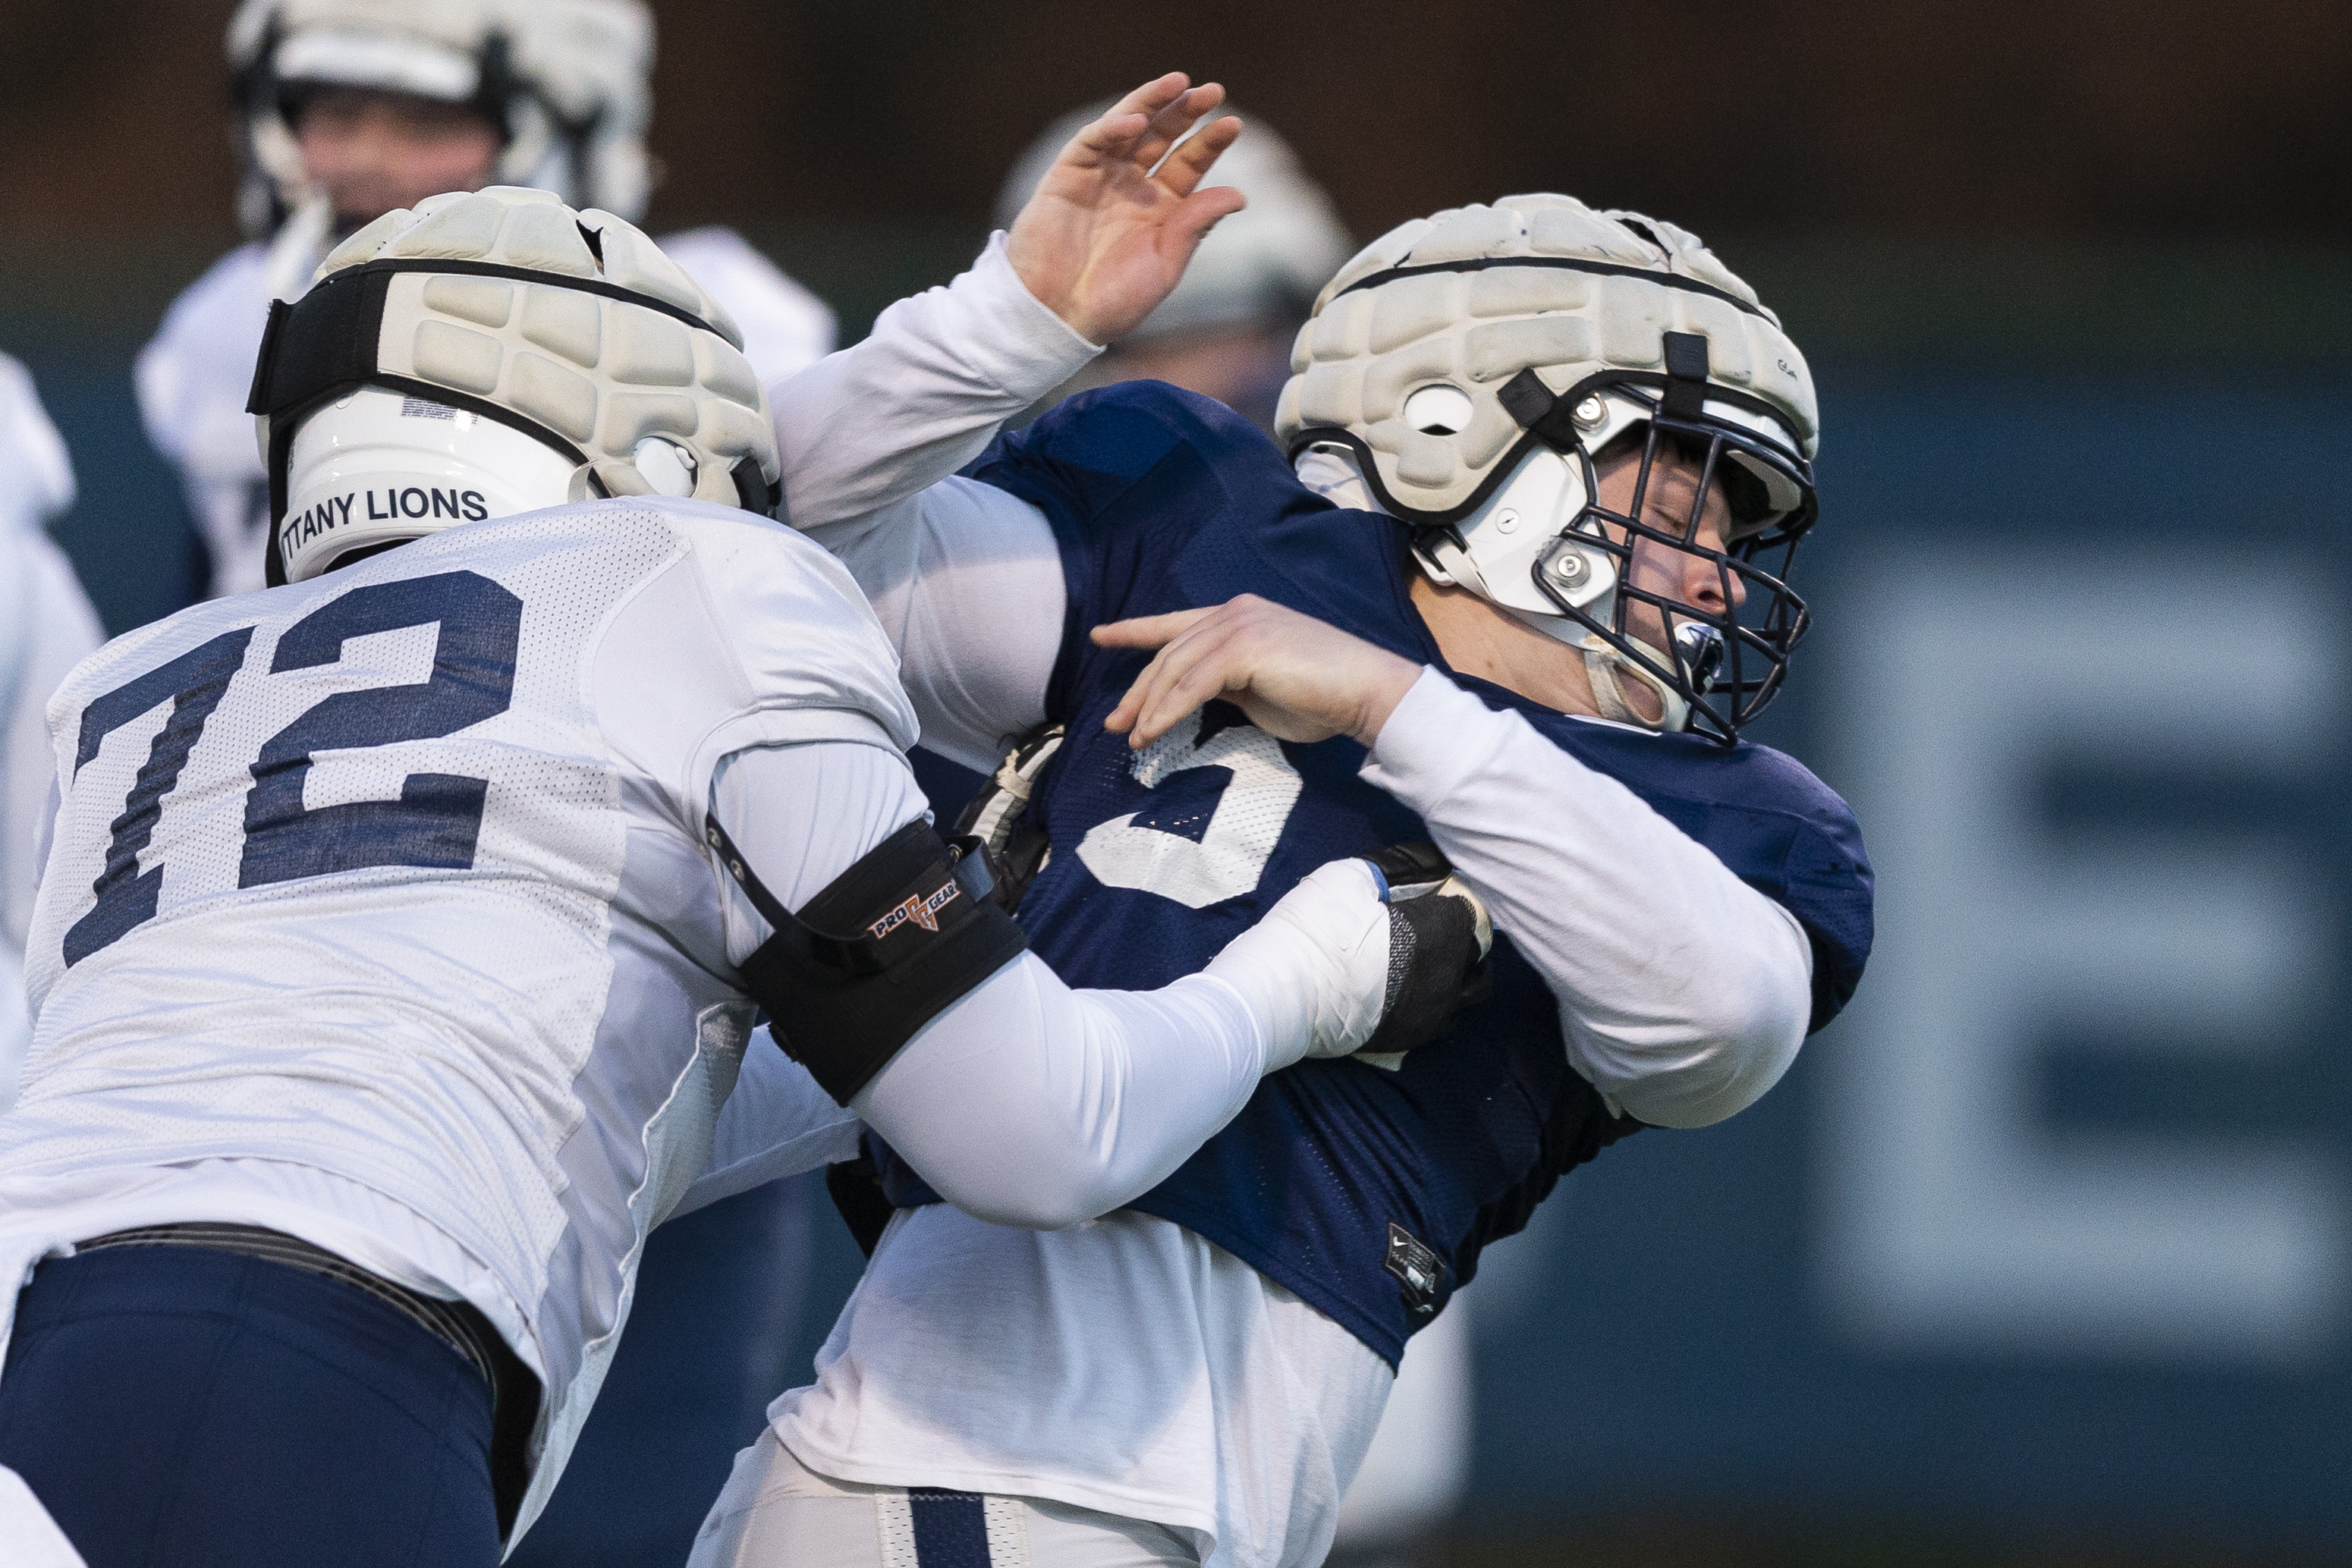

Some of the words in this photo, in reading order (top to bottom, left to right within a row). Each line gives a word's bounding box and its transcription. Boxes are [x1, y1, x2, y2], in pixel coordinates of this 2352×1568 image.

[366, 487, 489, 522] LIONS
[63, 570, 523, 969] 72
[876, 907, 907, 936] PRO
[928, 884, 957, 910] GEAR
